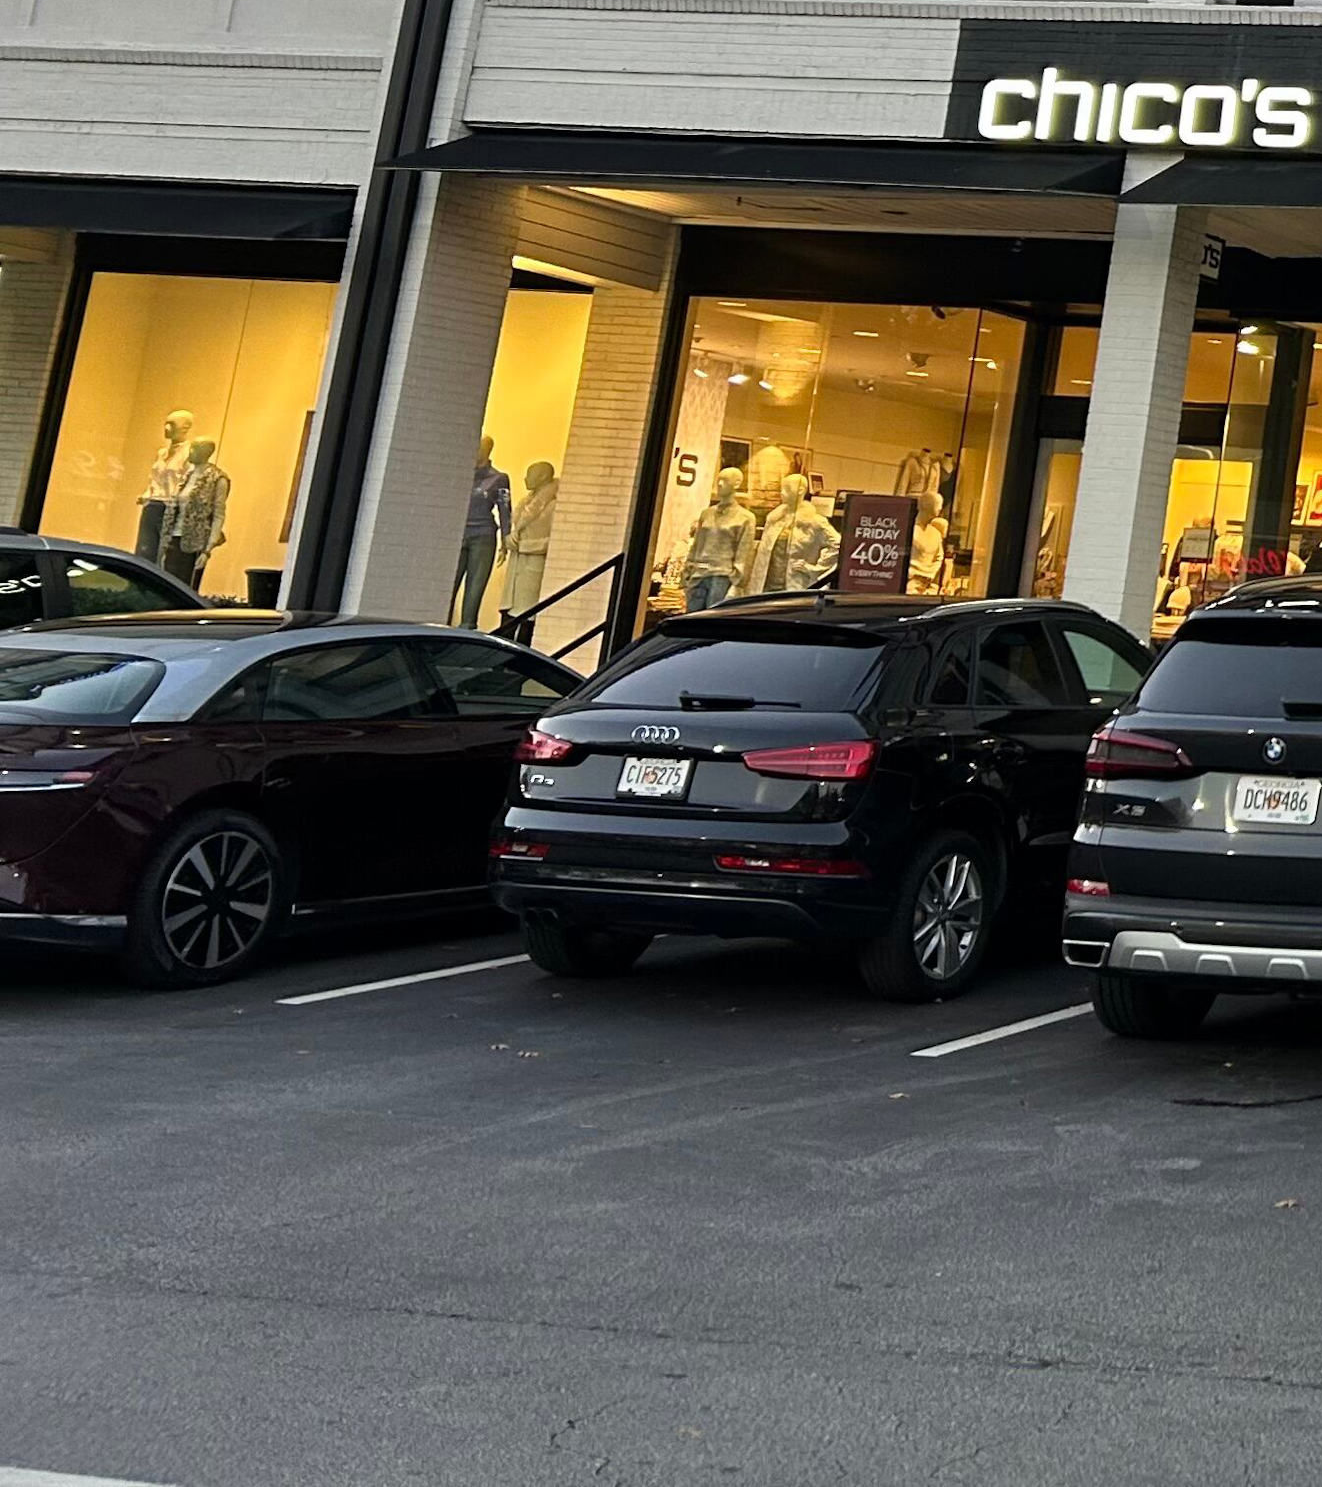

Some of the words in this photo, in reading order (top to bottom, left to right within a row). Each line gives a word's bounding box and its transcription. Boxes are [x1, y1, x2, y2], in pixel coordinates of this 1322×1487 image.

[977, 66, 1312, 149] chico's
[860, 515, 897, 529] BLACK
[855, 527, 900, 540] FRIDAY
[850, 542, 899, 566] 40%
